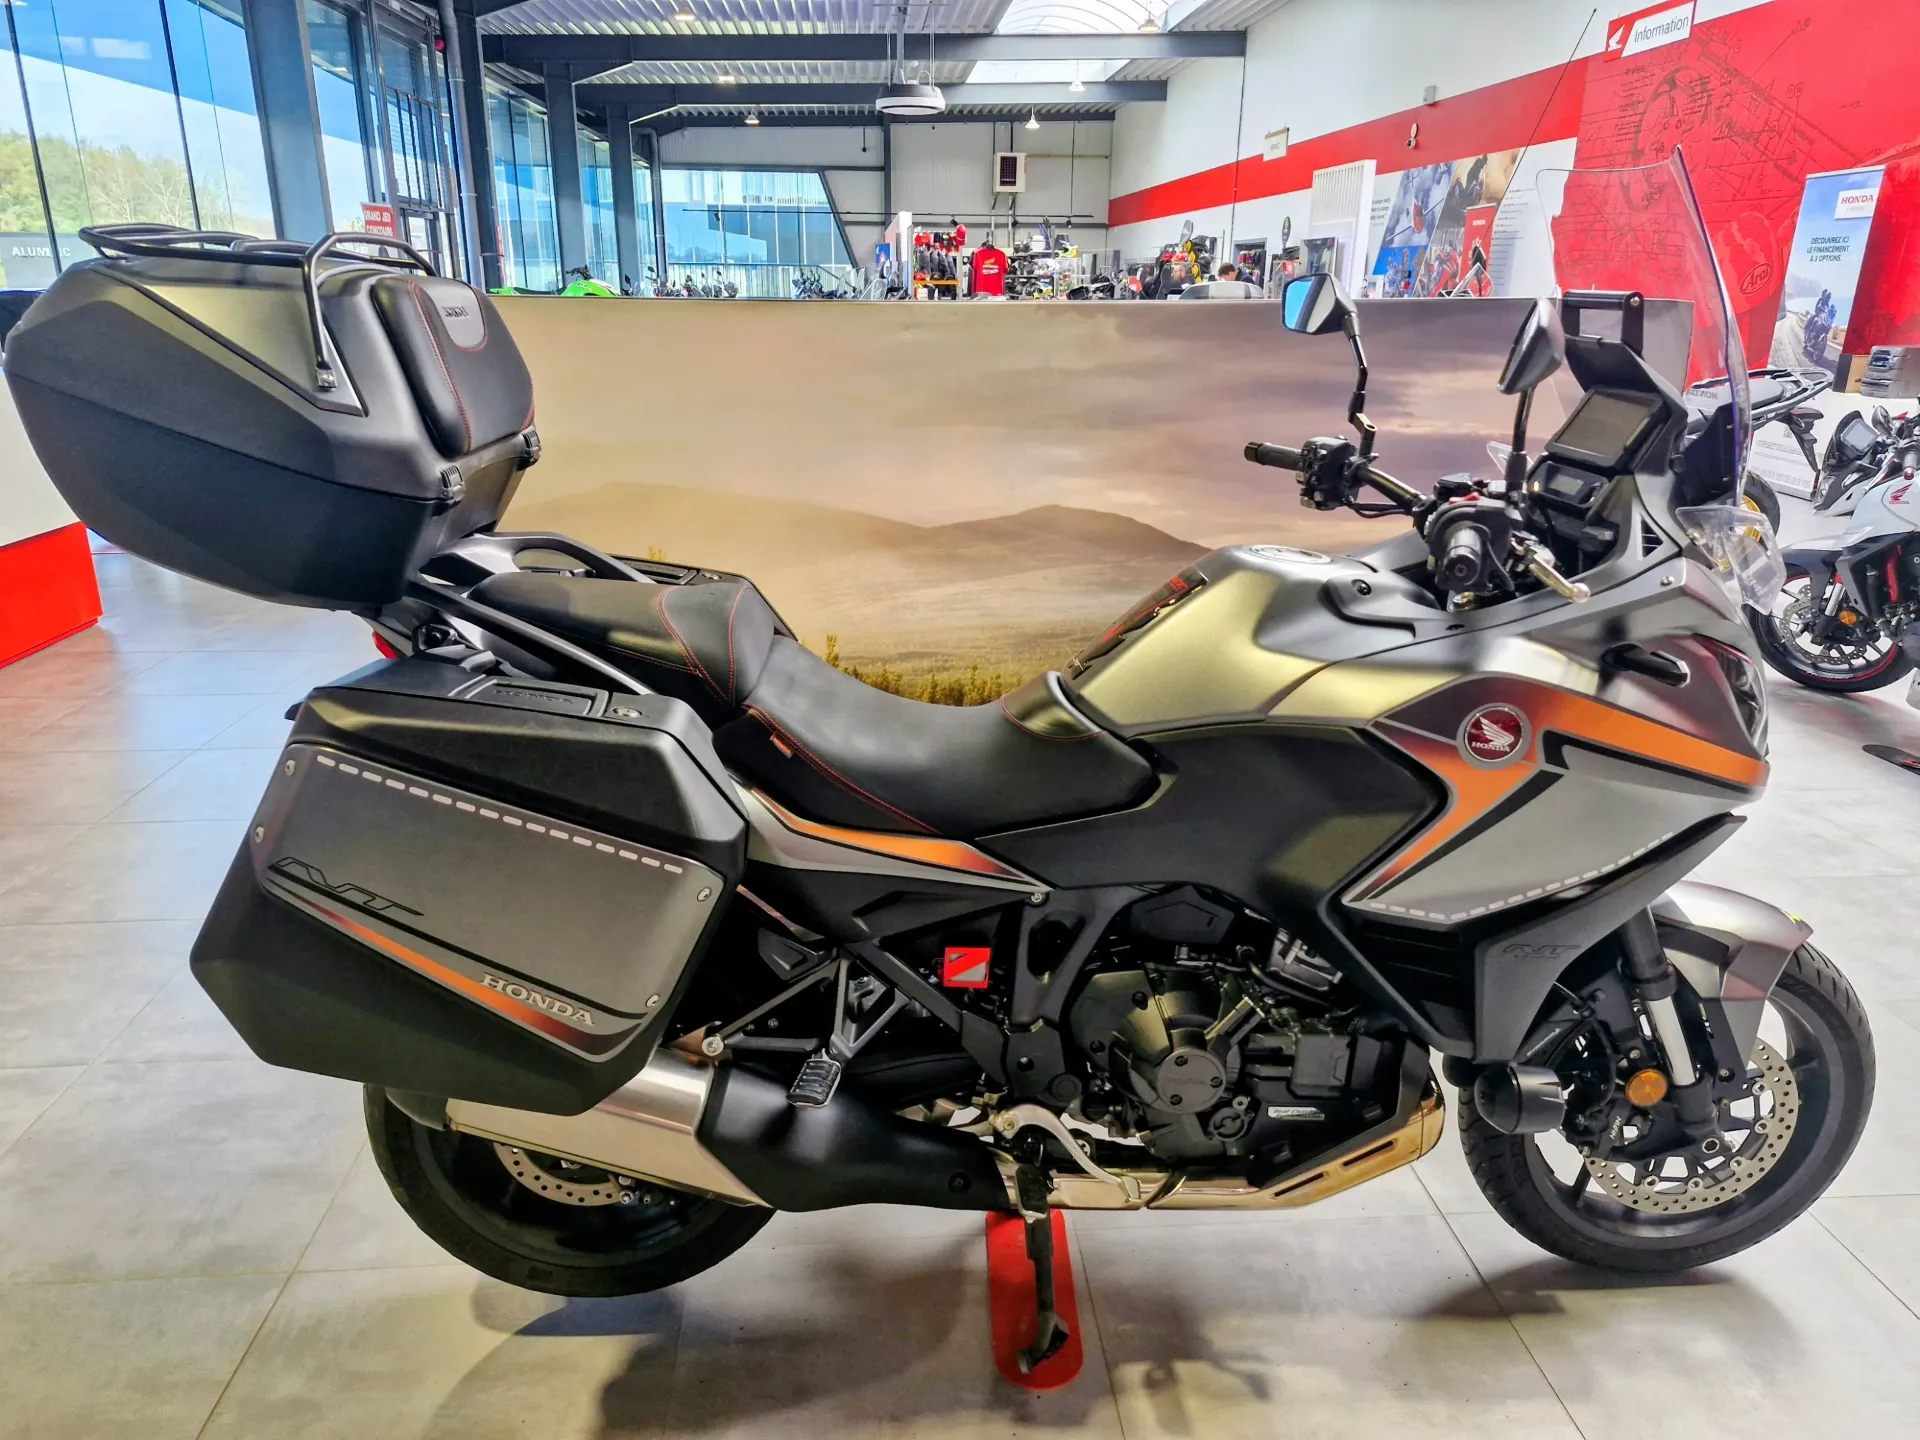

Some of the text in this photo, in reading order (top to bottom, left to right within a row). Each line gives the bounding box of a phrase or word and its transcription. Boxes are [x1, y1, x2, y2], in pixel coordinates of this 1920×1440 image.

[1634, 16, 1689, 43] Information
[1841, 195, 1874, 204] HONDA
[1842, 236, 1850, 244] ICI
[1471, 741, 1510, 752] HONDA
[480, 972, 596, 1026] HONDA
